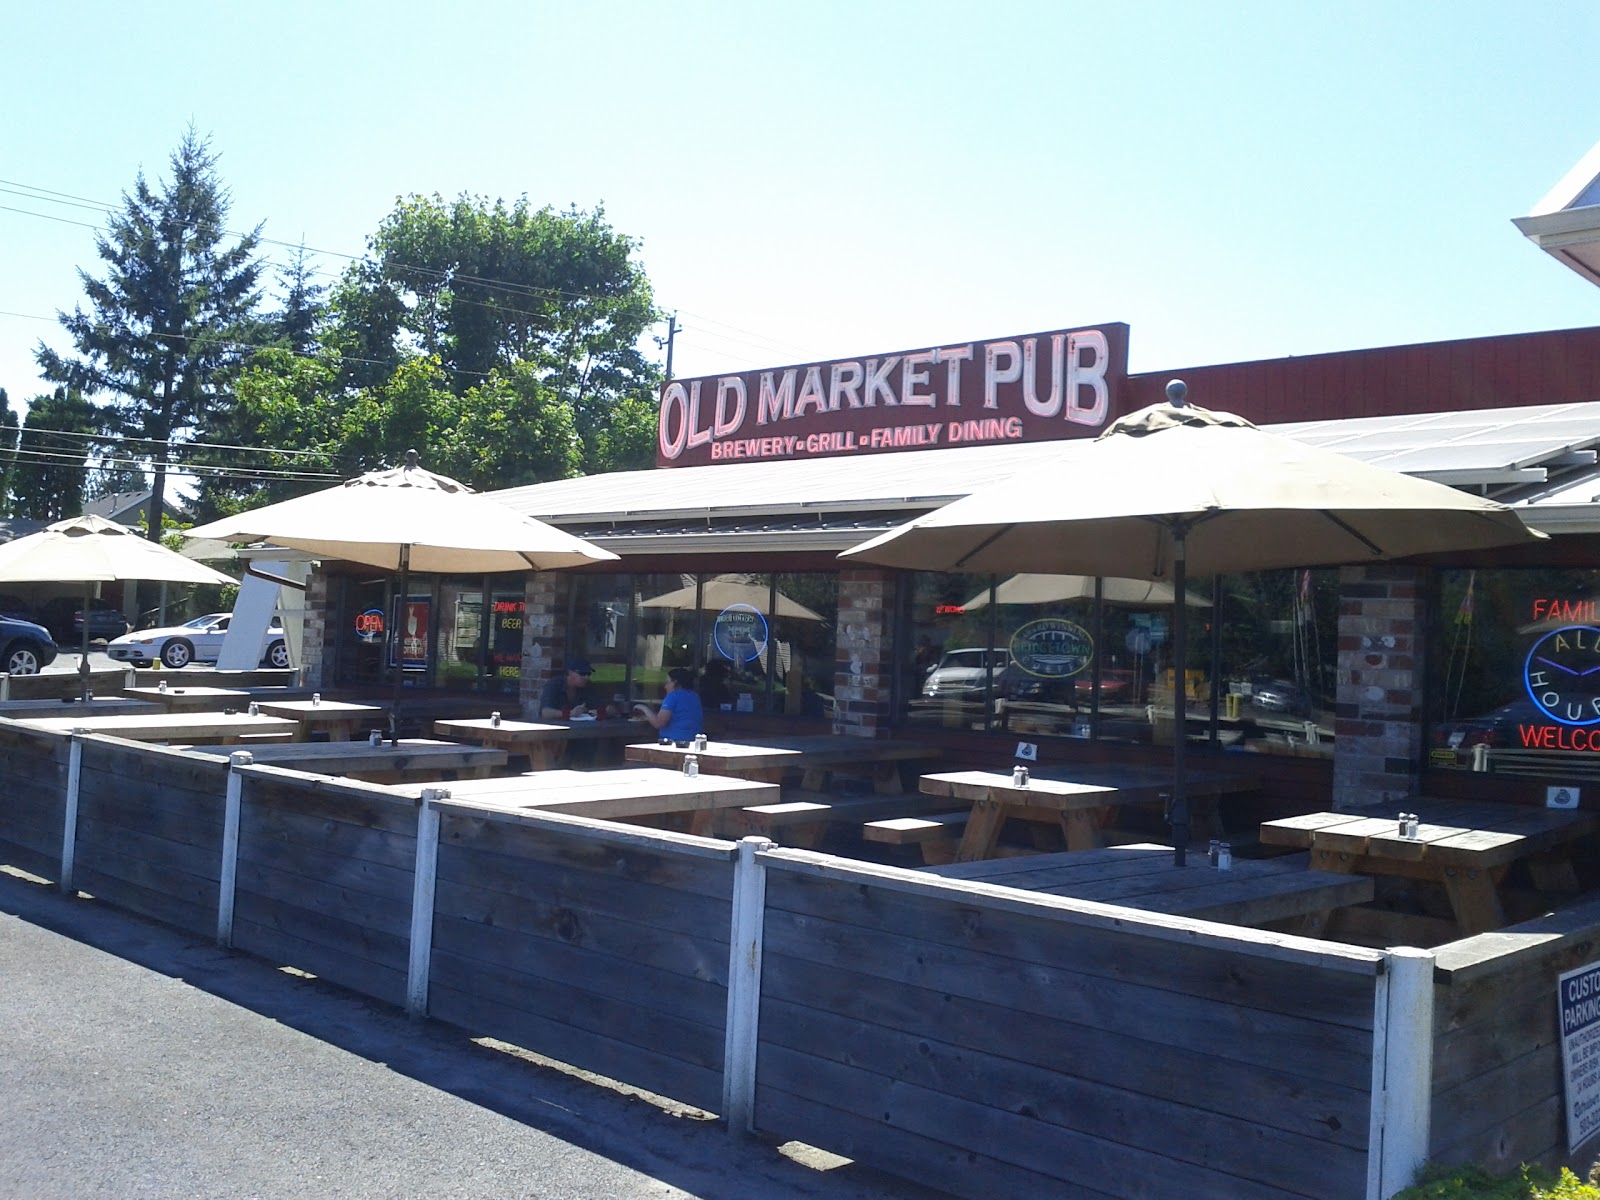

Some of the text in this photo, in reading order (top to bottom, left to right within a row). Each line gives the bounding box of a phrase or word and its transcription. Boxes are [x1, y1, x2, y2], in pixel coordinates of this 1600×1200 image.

[659, 329, 1109, 460] OLD MARKET PUB
[711, 416, 1022, 460] BREWERY GRILL FAMILY DINING
[355, 615, 384, 632] OPEN
[501, 618, 522, 629] BEER
